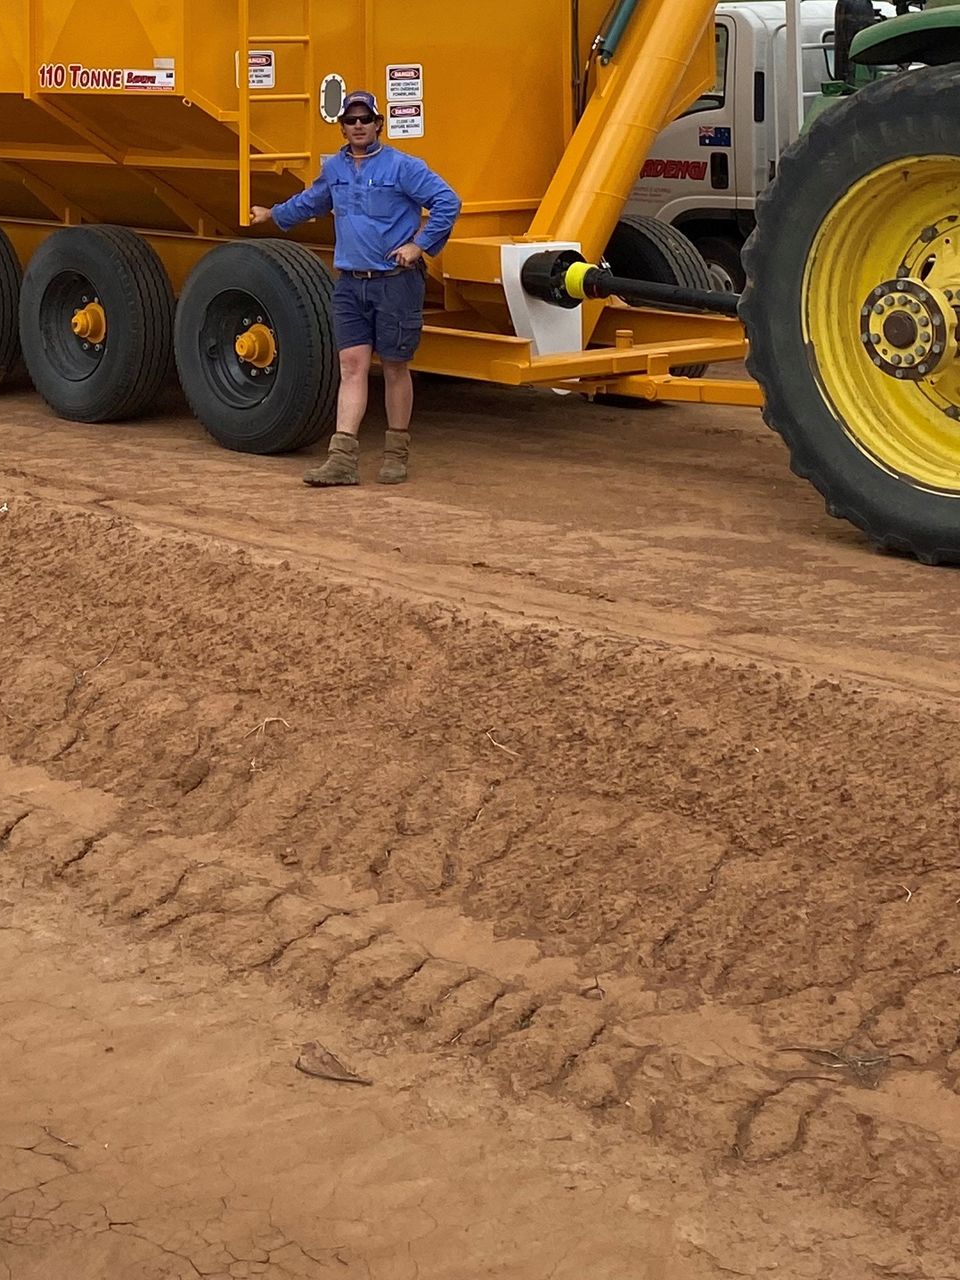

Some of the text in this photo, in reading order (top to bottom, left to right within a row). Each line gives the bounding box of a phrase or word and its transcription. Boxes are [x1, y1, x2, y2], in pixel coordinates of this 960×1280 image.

[39, 64, 66, 88] 110
[69, 64, 122, 89] TONNE
[394, 70, 415, 78] DANGER
